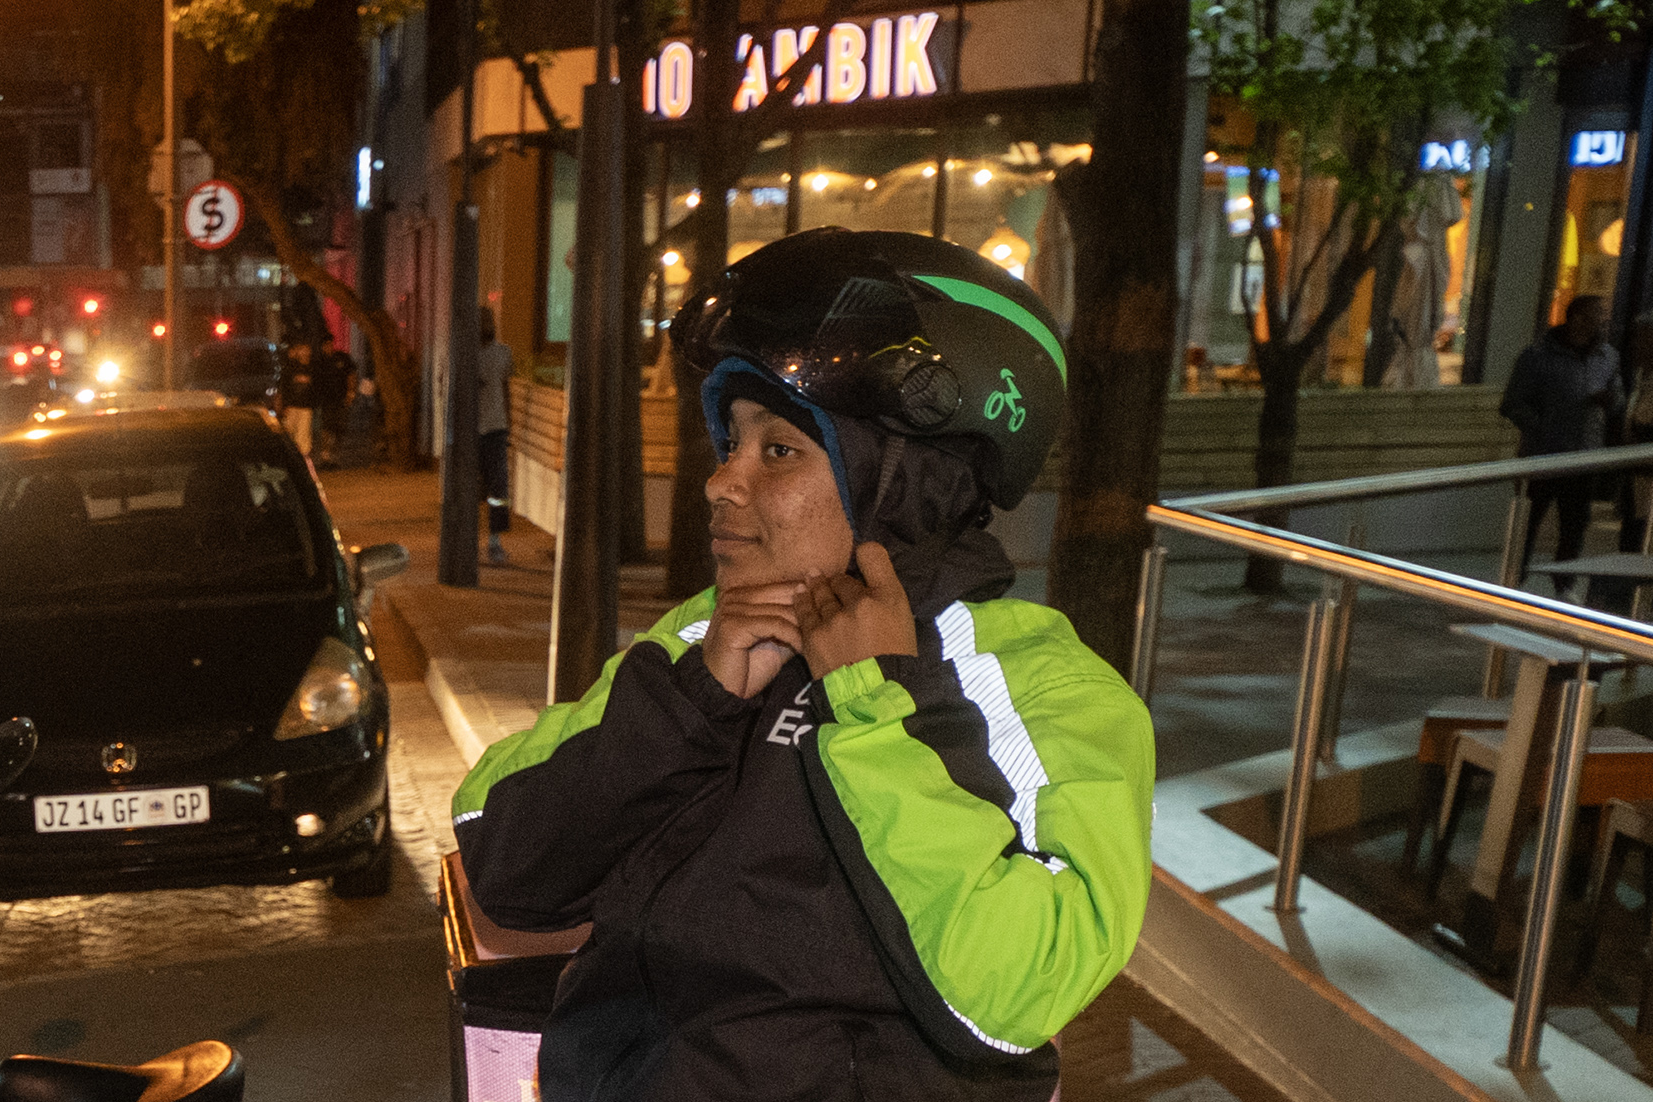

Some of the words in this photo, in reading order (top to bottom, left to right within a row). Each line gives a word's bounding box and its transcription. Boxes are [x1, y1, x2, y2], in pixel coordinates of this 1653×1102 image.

[643, 12, 938, 118] OAMBIK
[43, 801, 69, 827] JZ
[78, 800, 104, 825] 14
[113, 797, 139, 823] GF
[174, 792, 201, 819] GP
